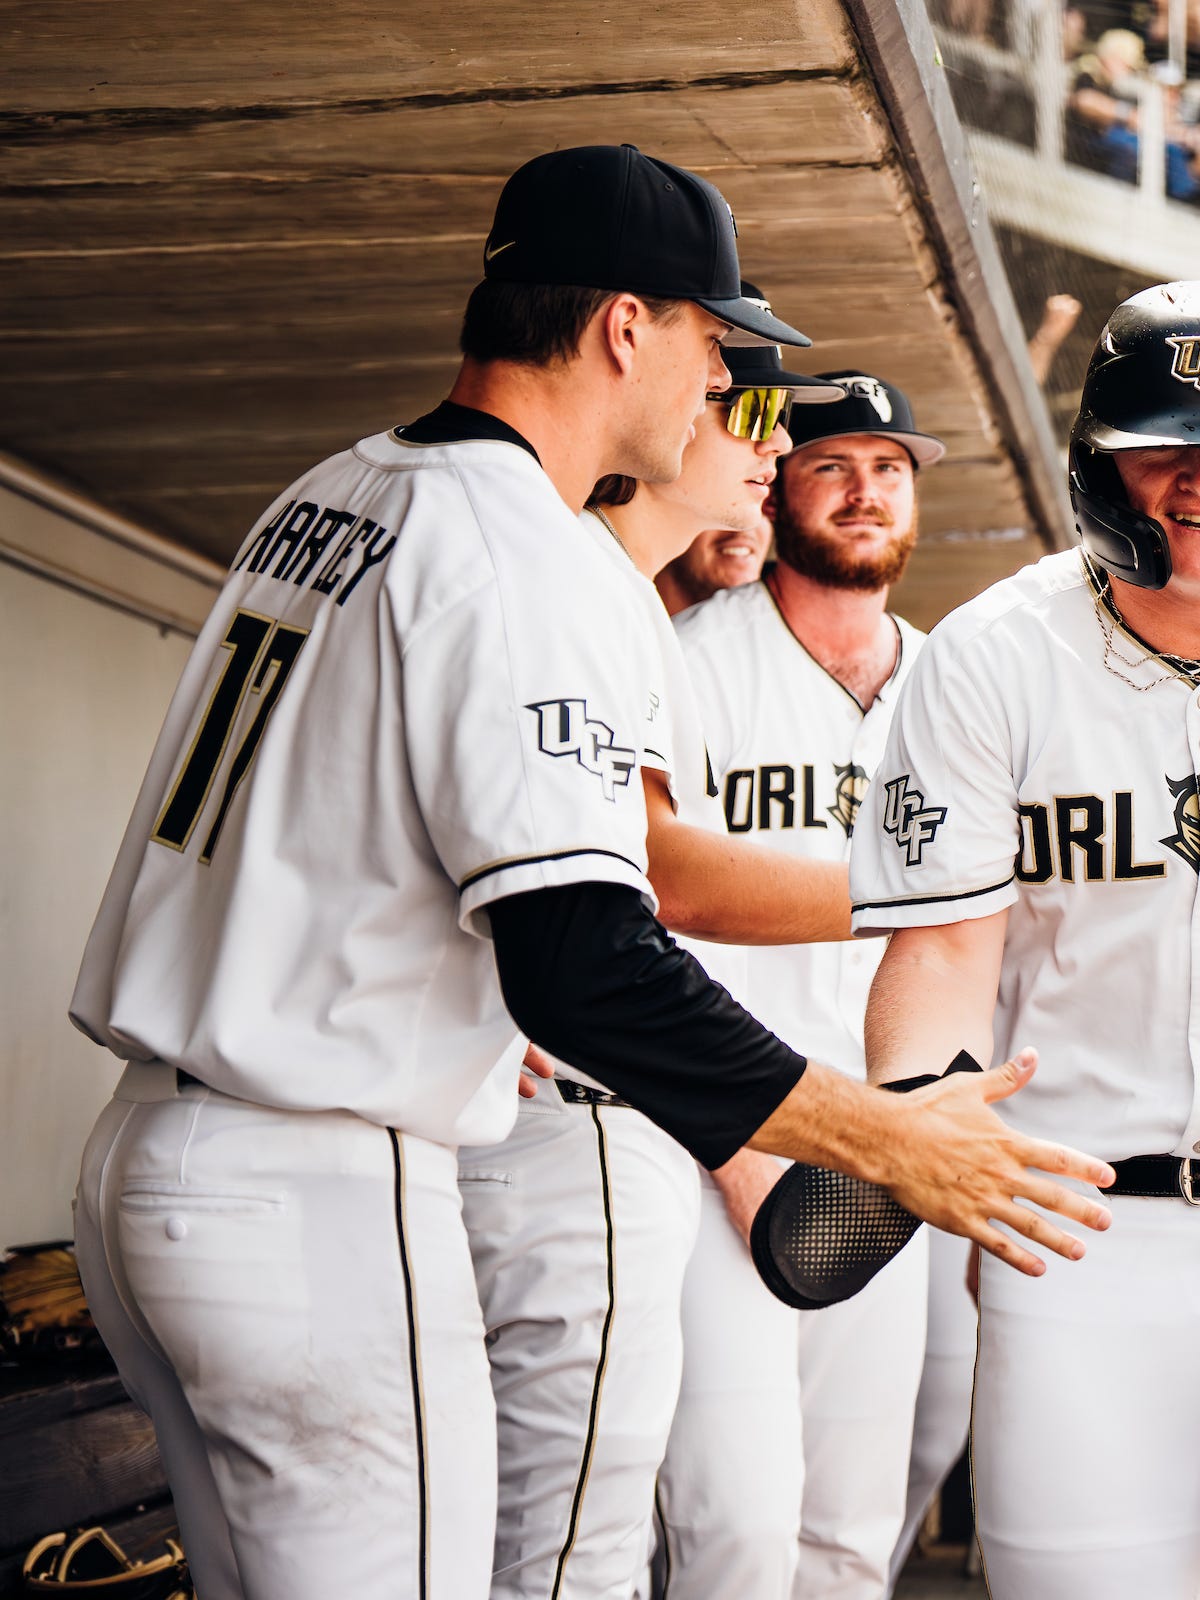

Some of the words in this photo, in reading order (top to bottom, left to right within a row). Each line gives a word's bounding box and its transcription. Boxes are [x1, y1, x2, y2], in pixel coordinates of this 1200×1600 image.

[150, 607, 312, 867] 17
[523, 698, 636, 803] UCF
[723, 762, 828, 836] ORL
[882, 774, 949, 867] UCF
[1014, 789, 1167, 886] ORL
